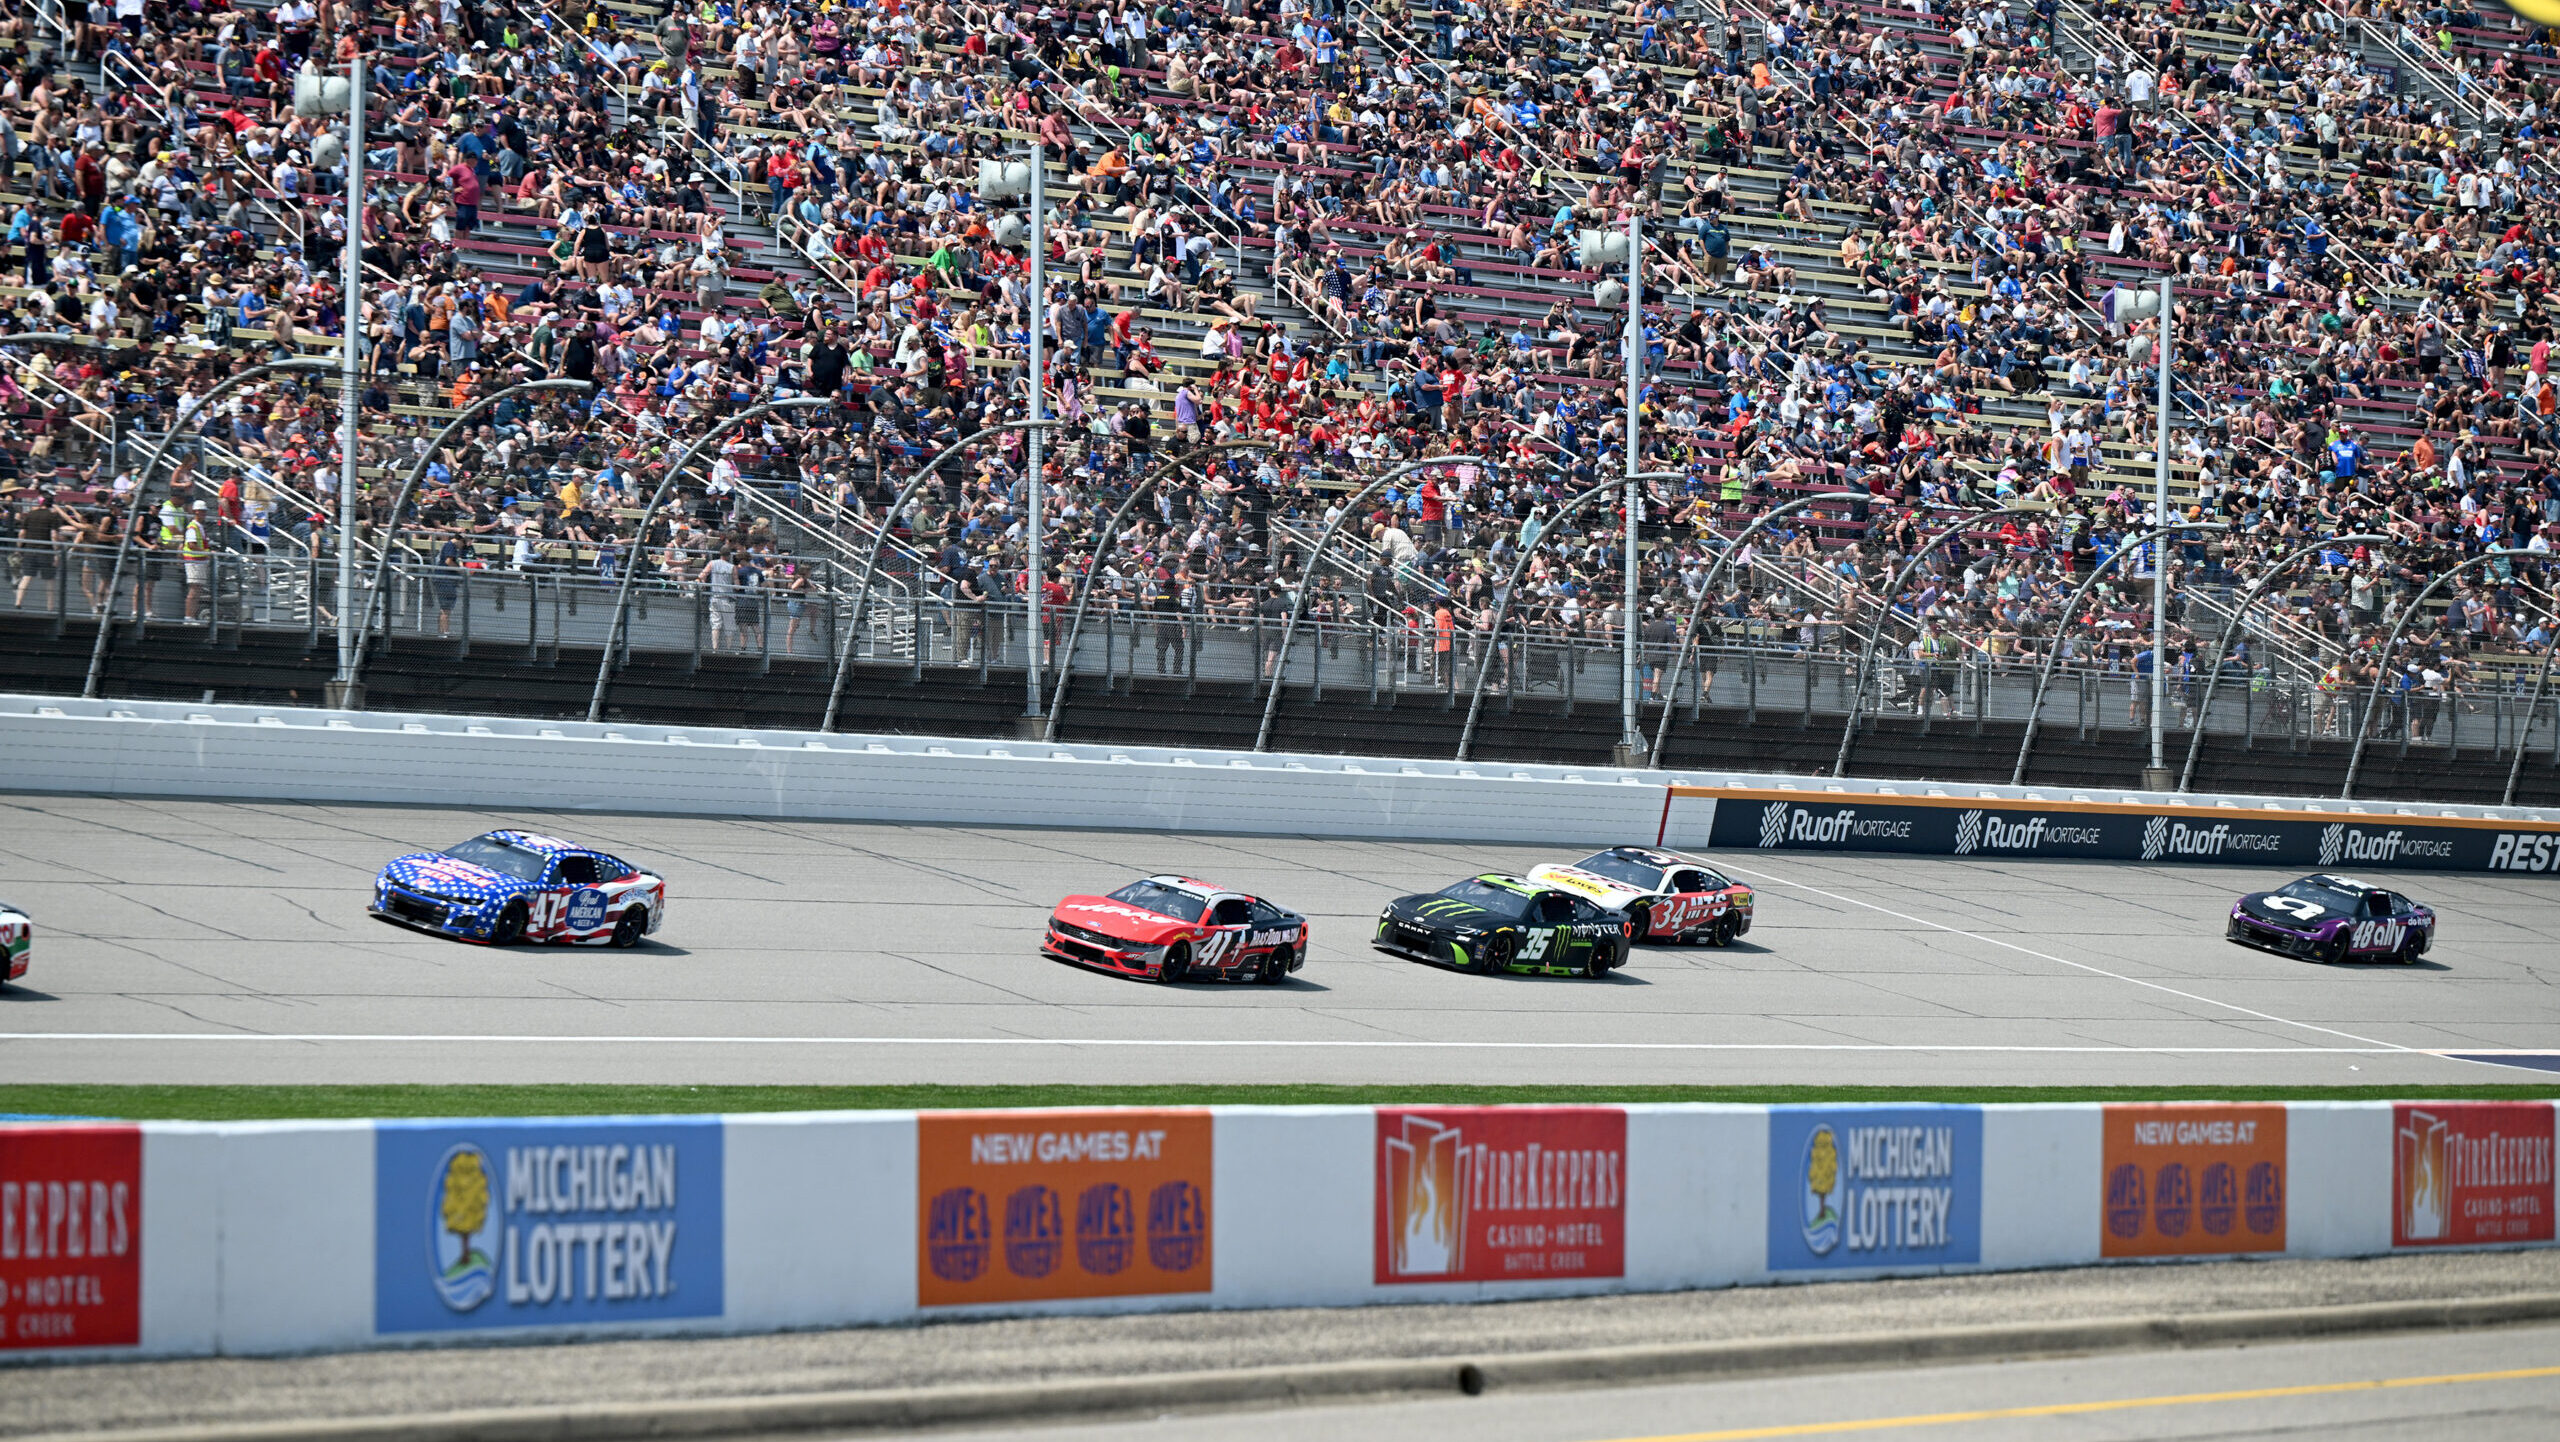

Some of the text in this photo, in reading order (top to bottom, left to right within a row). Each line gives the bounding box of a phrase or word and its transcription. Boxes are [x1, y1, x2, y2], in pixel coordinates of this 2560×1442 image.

[1788, 808, 1912, 842] Ruoff MORTGAGE
[1982, 816, 2101, 849] Ruoff MORTGAGE
[2168, 822, 2281, 855] Ruoff MORTGAGE
[2344, 829, 2453, 861] Ruoff MORTGAGE
[532, 892, 562, 929] 47
[569, 906, 603, 920] AMERICAN
[1655, 899, 1687, 930] 34
[1516, 927, 1555, 960] 35
[1572, 922, 1621, 938] MONSTER
[2352, 918, 2407, 953] 48 ally
[1198, 931, 1233, 967] 41
[971, 1130, 1166, 1163] NEW GAMES AT
[2134, 1121, 2257, 1146] NEW GAMES AT
[1848, 1126, 1952, 1178] MICHIGAN
[505, 1143, 677, 1214] MICHIGAN
[1, 1180, 129, 1259] EEPERS
[1847, 1186, 1952, 1249] LOTTERY
[2464, 1196, 2541, 1218] CASINO HOTEL
[1487, 1223, 1603, 1247] CASINO HOTEL
[505, 1219, 676, 1304] LOTTERY
[26, 1275, 104, 1307] HOTEL
